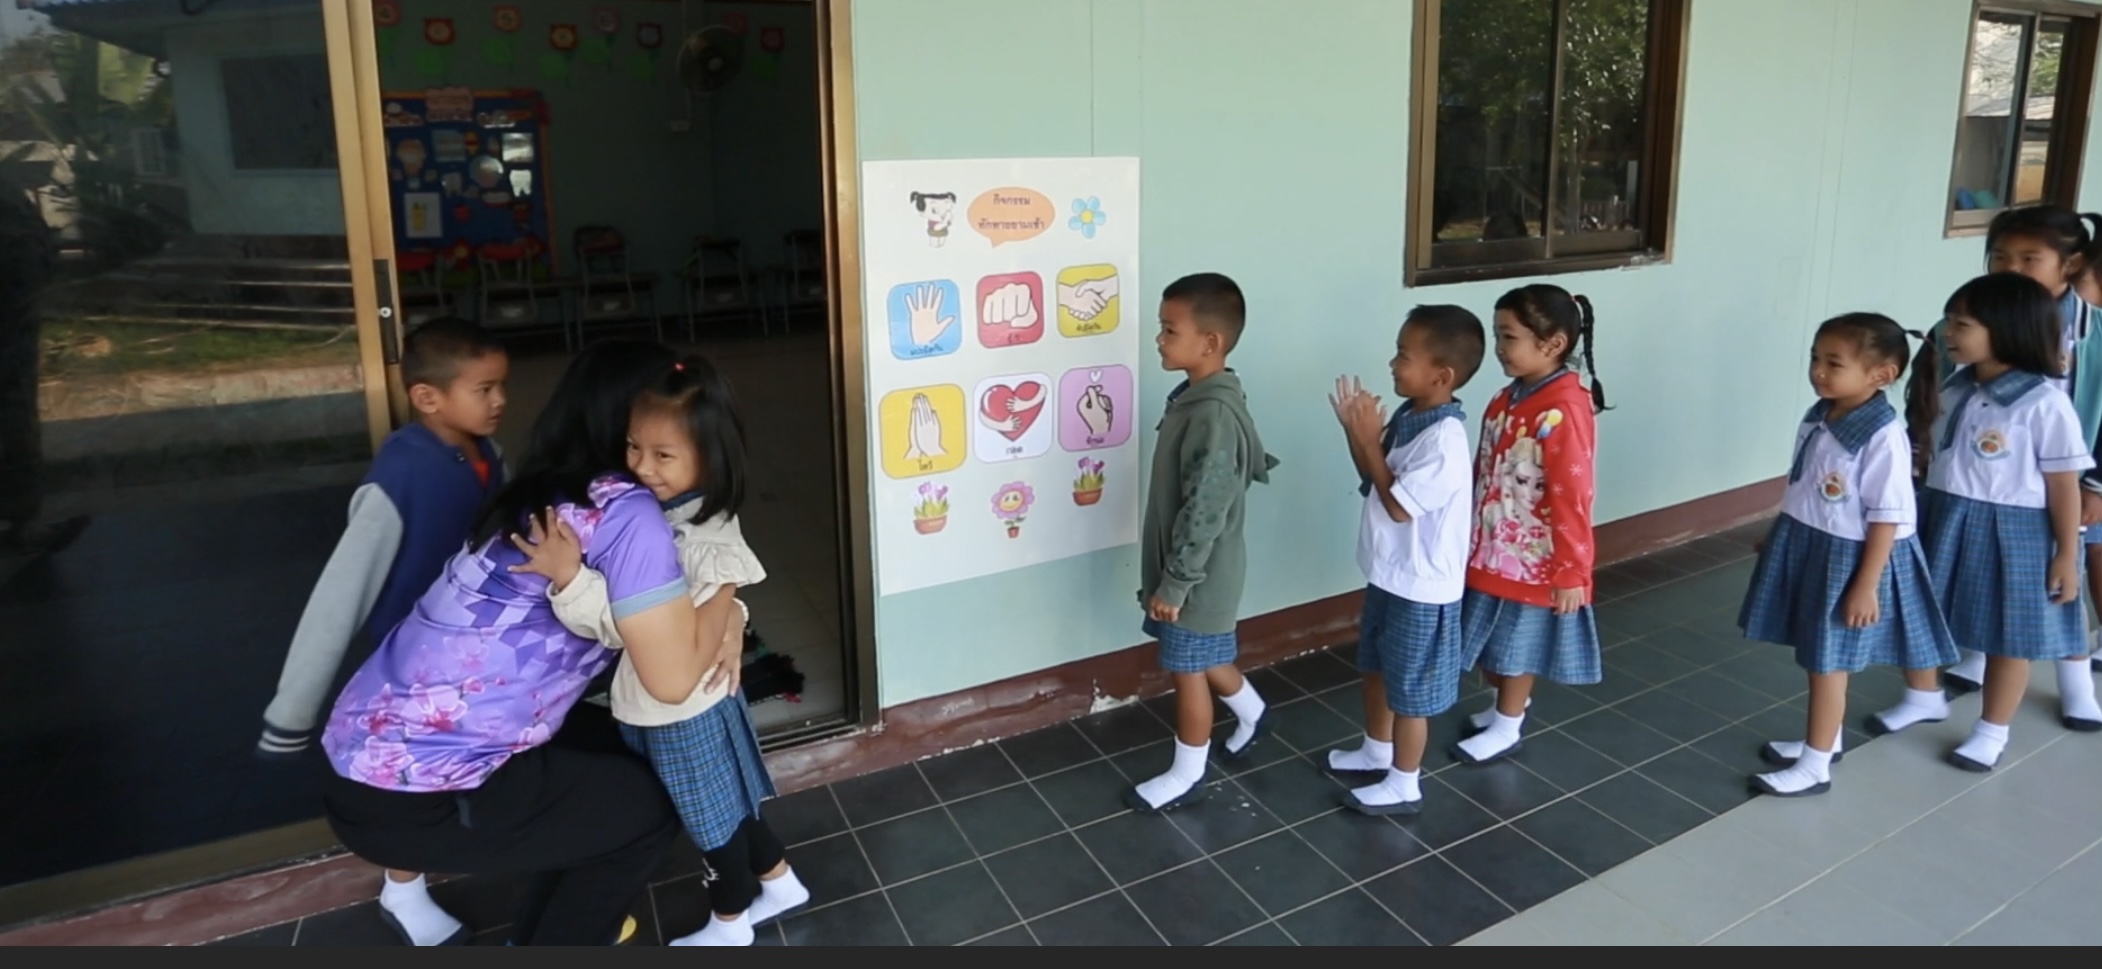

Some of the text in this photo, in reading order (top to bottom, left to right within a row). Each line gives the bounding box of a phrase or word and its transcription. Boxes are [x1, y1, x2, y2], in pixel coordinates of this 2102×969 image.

[993, 193, 1031, 205] กิจกรรม
[977, 217, 1045, 229] ทักทายยามเช้า
